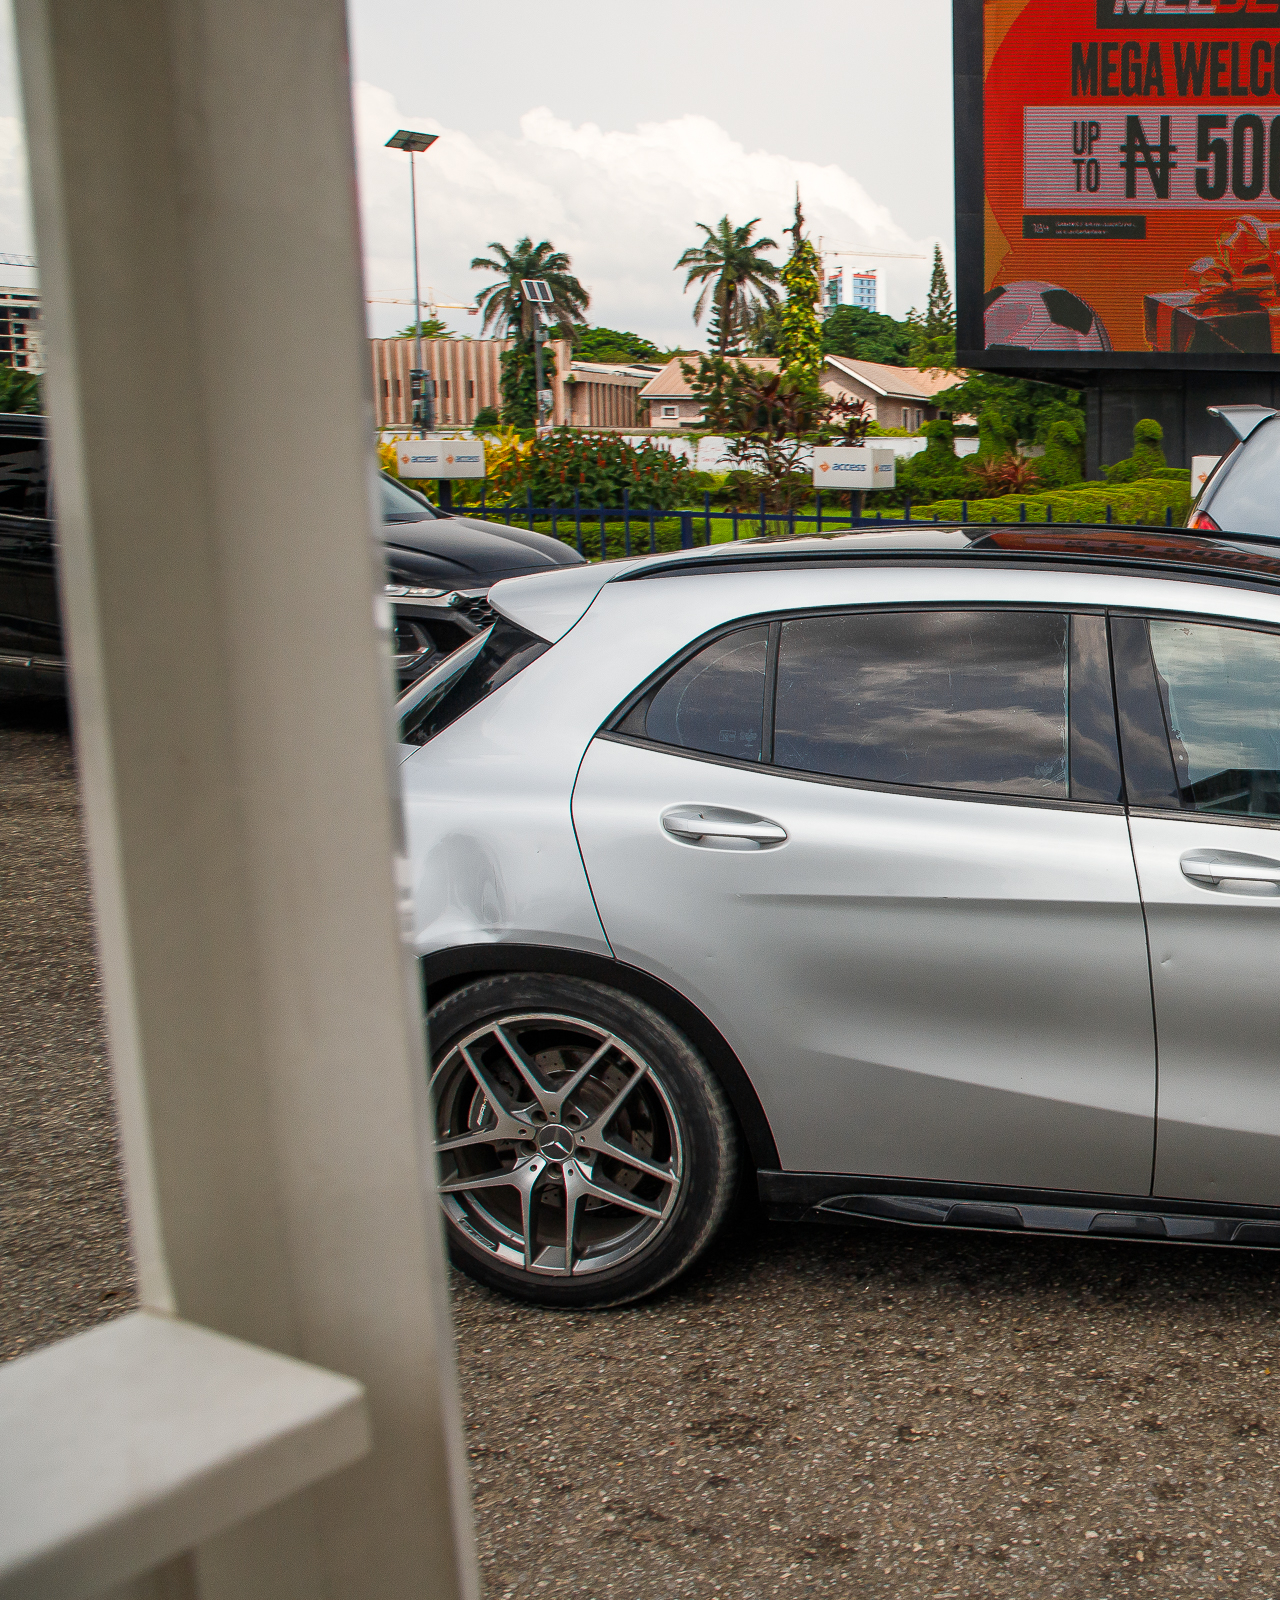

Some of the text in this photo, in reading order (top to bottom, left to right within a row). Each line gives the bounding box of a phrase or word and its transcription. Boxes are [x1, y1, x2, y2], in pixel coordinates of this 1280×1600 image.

[1071, 41, 1165, 97] MEGA
[1072, 121, 1099, 155] UP
[1072, 158, 1100, 193] TO
[832, 463, 867, 471] access
